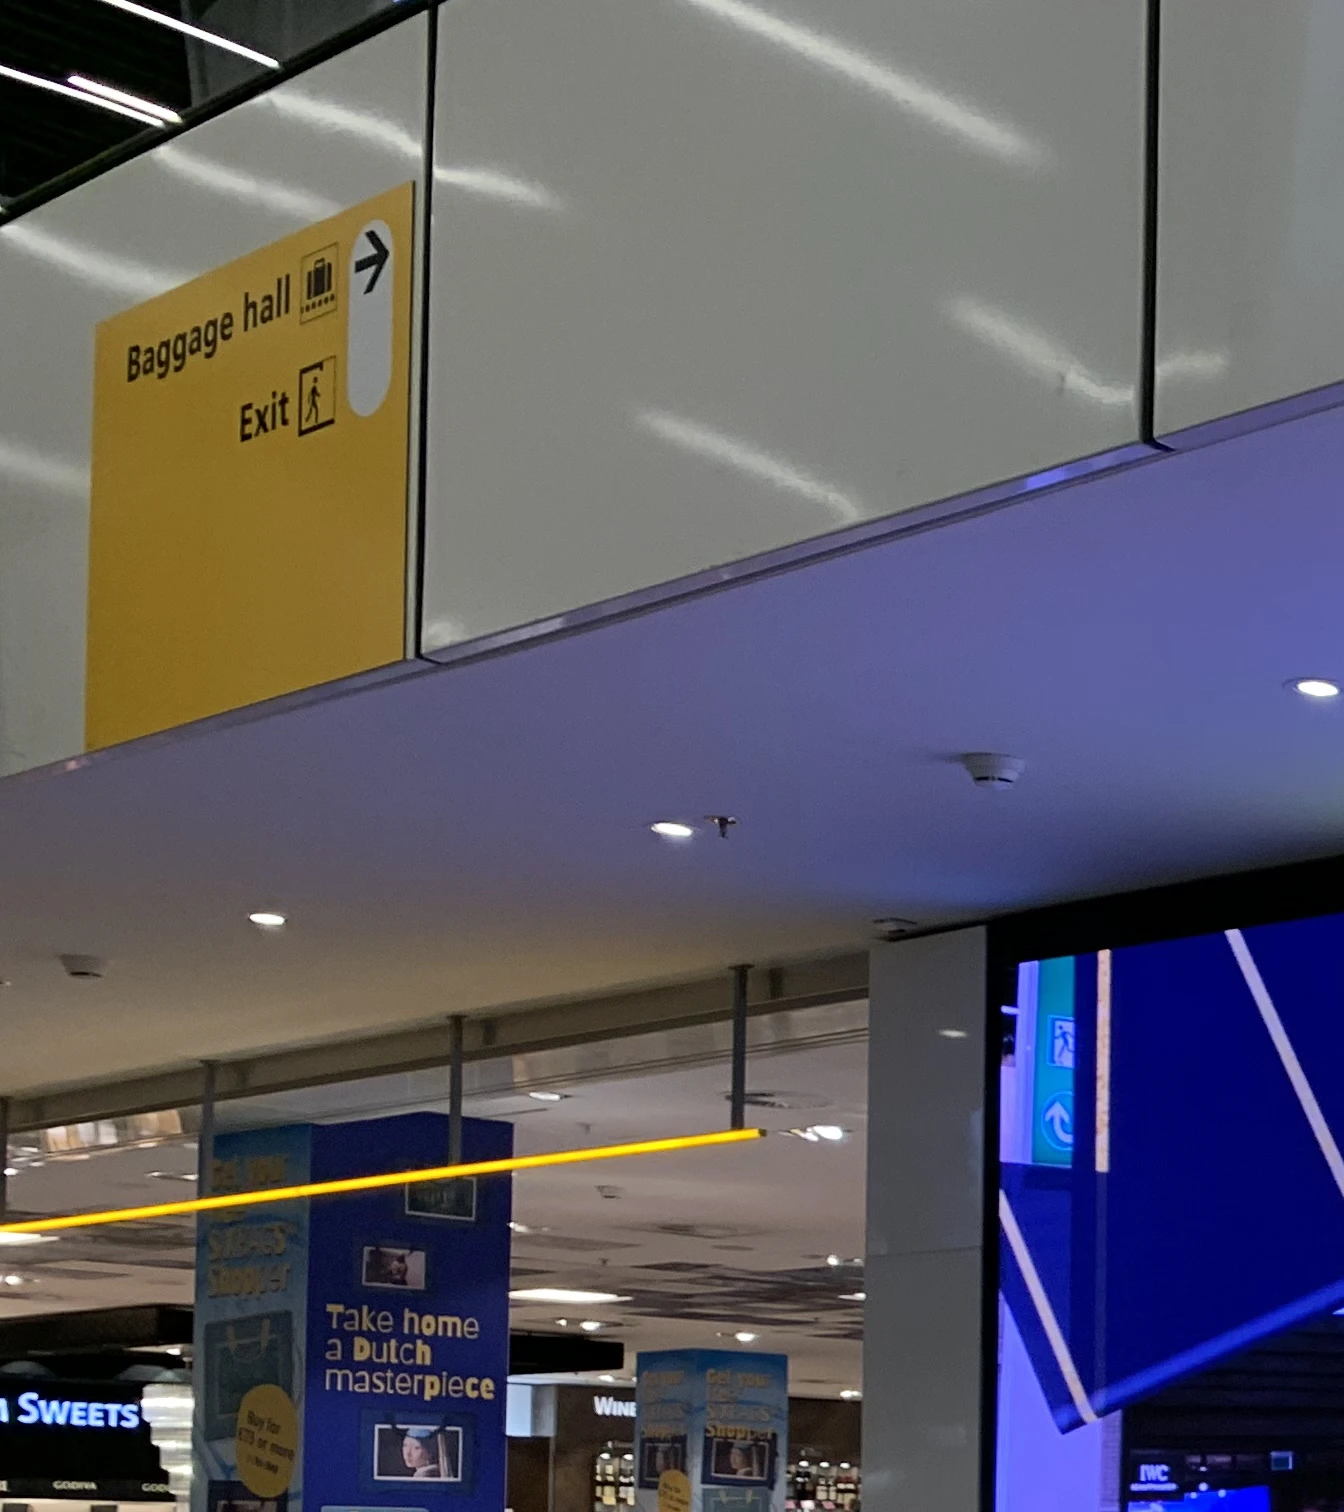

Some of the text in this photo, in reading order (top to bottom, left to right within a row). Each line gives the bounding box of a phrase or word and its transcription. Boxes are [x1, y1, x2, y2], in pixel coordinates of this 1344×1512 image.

[127, 273, 290, 382] Baggage hall
[240, 390, 289, 442] Exit
[326, 1304, 480, 1339] Take home
[325, 1336, 432, 1366] a Dutch
[325, 1367, 496, 1401] masterpiece
[17, 1391, 140, 1428] SWEETS
